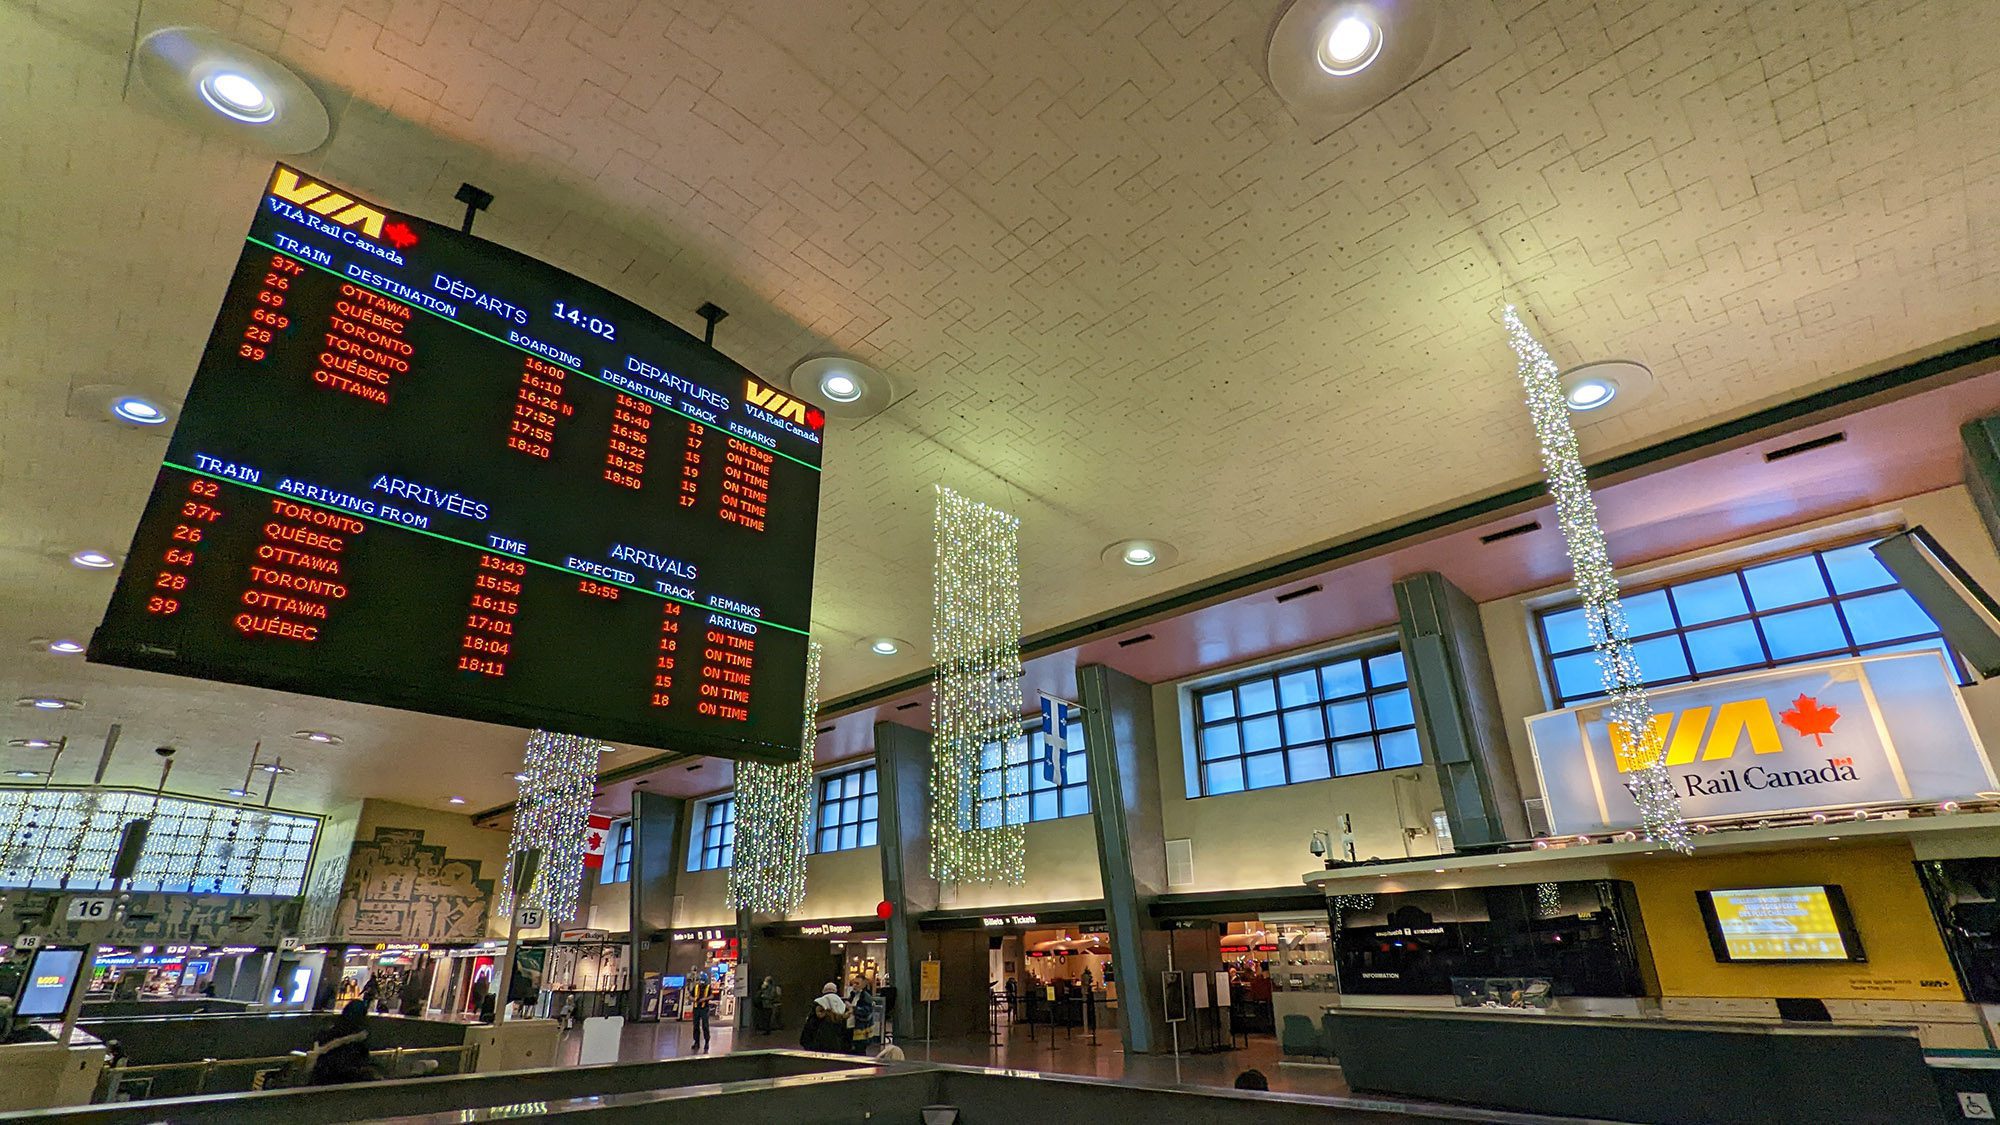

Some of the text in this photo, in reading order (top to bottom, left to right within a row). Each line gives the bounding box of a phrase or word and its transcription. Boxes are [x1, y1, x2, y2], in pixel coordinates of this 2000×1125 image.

[273, 168, 386, 239] VIA
[270, 198, 404, 265] VIA Rail Canada
[276, 234, 331, 265] TRAIN
[272, 255, 303, 275] 37r
[265, 272, 289, 290] 26
[348, 264, 457, 317] DESTINATION
[259, 291, 284, 306] 69
[341, 284, 412, 320] OTTAWA
[434, 274, 528, 324] DÉPARTS
[254, 308, 289, 329] 669
[336, 300, 404, 334] QUÉBEC
[554, 301, 616, 341] 14:02
[246, 326, 271, 343] 28
[330, 316, 414, 355] TORONTO
[240, 344, 265, 361] 39
[325, 334, 409, 373] TORONTO
[509, 331, 581, 368] BOARDING
[319, 351, 390, 386] QUÉBEC
[525, 357, 566, 380] 16:00
[314, 370, 388, 404] OTTAWA
[522, 372, 562, 396] 16:10
[603, 369, 673, 406] DEPARTURE
[627, 357, 731, 411] DEPARTURES
[518, 388, 573, 416] 16:26 N
[617, 394, 652, 415] 16:30
[682, 401, 717, 424] TRACK
[745, 380, 806, 425] VIA
[515, 405, 556, 427] 17:52
[615, 409, 650, 430] 16:40
[745, 403, 820, 444] VIA Rail Canada
[511, 420, 553, 442] 17:55
[612, 424, 648, 444] 16:56
[689, 423, 705, 436] 13
[729, 422, 777, 449] REMARKS
[508, 436, 549, 459] 18:20
[610, 439, 646, 459] 18:22
[687, 437, 703, 449] 17
[728, 438, 774, 464] Chk Bags
[197, 454, 260, 483] TRAIN
[607, 454, 643, 474] 18:25
[685, 452, 700, 464] 15
[727, 453, 770, 475] ON TIME
[604, 470, 641, 490] 18:50
[684, 466, 699, 478] 19
[725, 467, 769, 489] ON TIME
[192, 481, 219, 498] 62
[373, 475, 488, 520] ARRIVÉES
[682, 481, 697, 493] 15
[723, 481, 767, 503] ON TIME
[280, 479, 428, 529] ARRIVING FROM
[680, 495, 695, 508] 17
[721, 495, 766, 518] ON TIME
[182, 502, 222, 523] 37r
[272, 499, 364, 535] TORONTO
[720, 509, 764, 532] ON TIME
[174, 525, 202, 543] 26
[265, 523, 343, 552] QUÉBEC
[490, 535, 527, 555] TIME
[166, 549, 194, 566] 64
[259, 545, 339, 575] OTTAWA
[481, 554, 526, 576] 13:43
[612, 544, 697, 580] ARRIVALS
[158, 572, 186, 590] 28
[568, 557, 635, 584] EXPECTED
[251, 567, 347, 599] TORONTO
[476, 575, 521, 596] 15:54
[579, 580, 619, 600] 13:55
[657, 581, 696, 600] TRACK
[149, 598, 179, 614] 39
[242, 591, 327, 620] OTTAWA
[472, 594, 517, 615] 16:15
[665, 602, 681, 616] 14
[710, 596, 761, 619] REMARKS
[235, 614, 318, 642] QUÉBEC
[467, 615, 513, 636] 17:01
[663, 621, 679, 634] 14
[709, 614, 758, 635] ARRIVED
[463, 635, 509, 656] 18:04
[660, 638, 677, 652] 18
[707, 631, 754, 652] ON TIME
[458, 656, 505, 677] 18:11
[658, 656, 675, 670] 15
[705, 649, 753, 669] ON TIME
[655, 674, 672, 688] 15
[703, 667, 751, 687] ON TIME
[653, 693, 670, 707] 18
[701, 684, 750, 703] ON TIME
[699, 702, 748, 722] ON TIME
[1607, 698, 1783, 773] VIA
[1683, 770, 1742, 796] Rail
[1744, 758, 1860, 790] Canada
[79, 901, 104, 917] 16
[521, 912, 537, 925] 15
[1011, 915, 1037, 925] Tickets
[22, 937, 36, 947] 18
